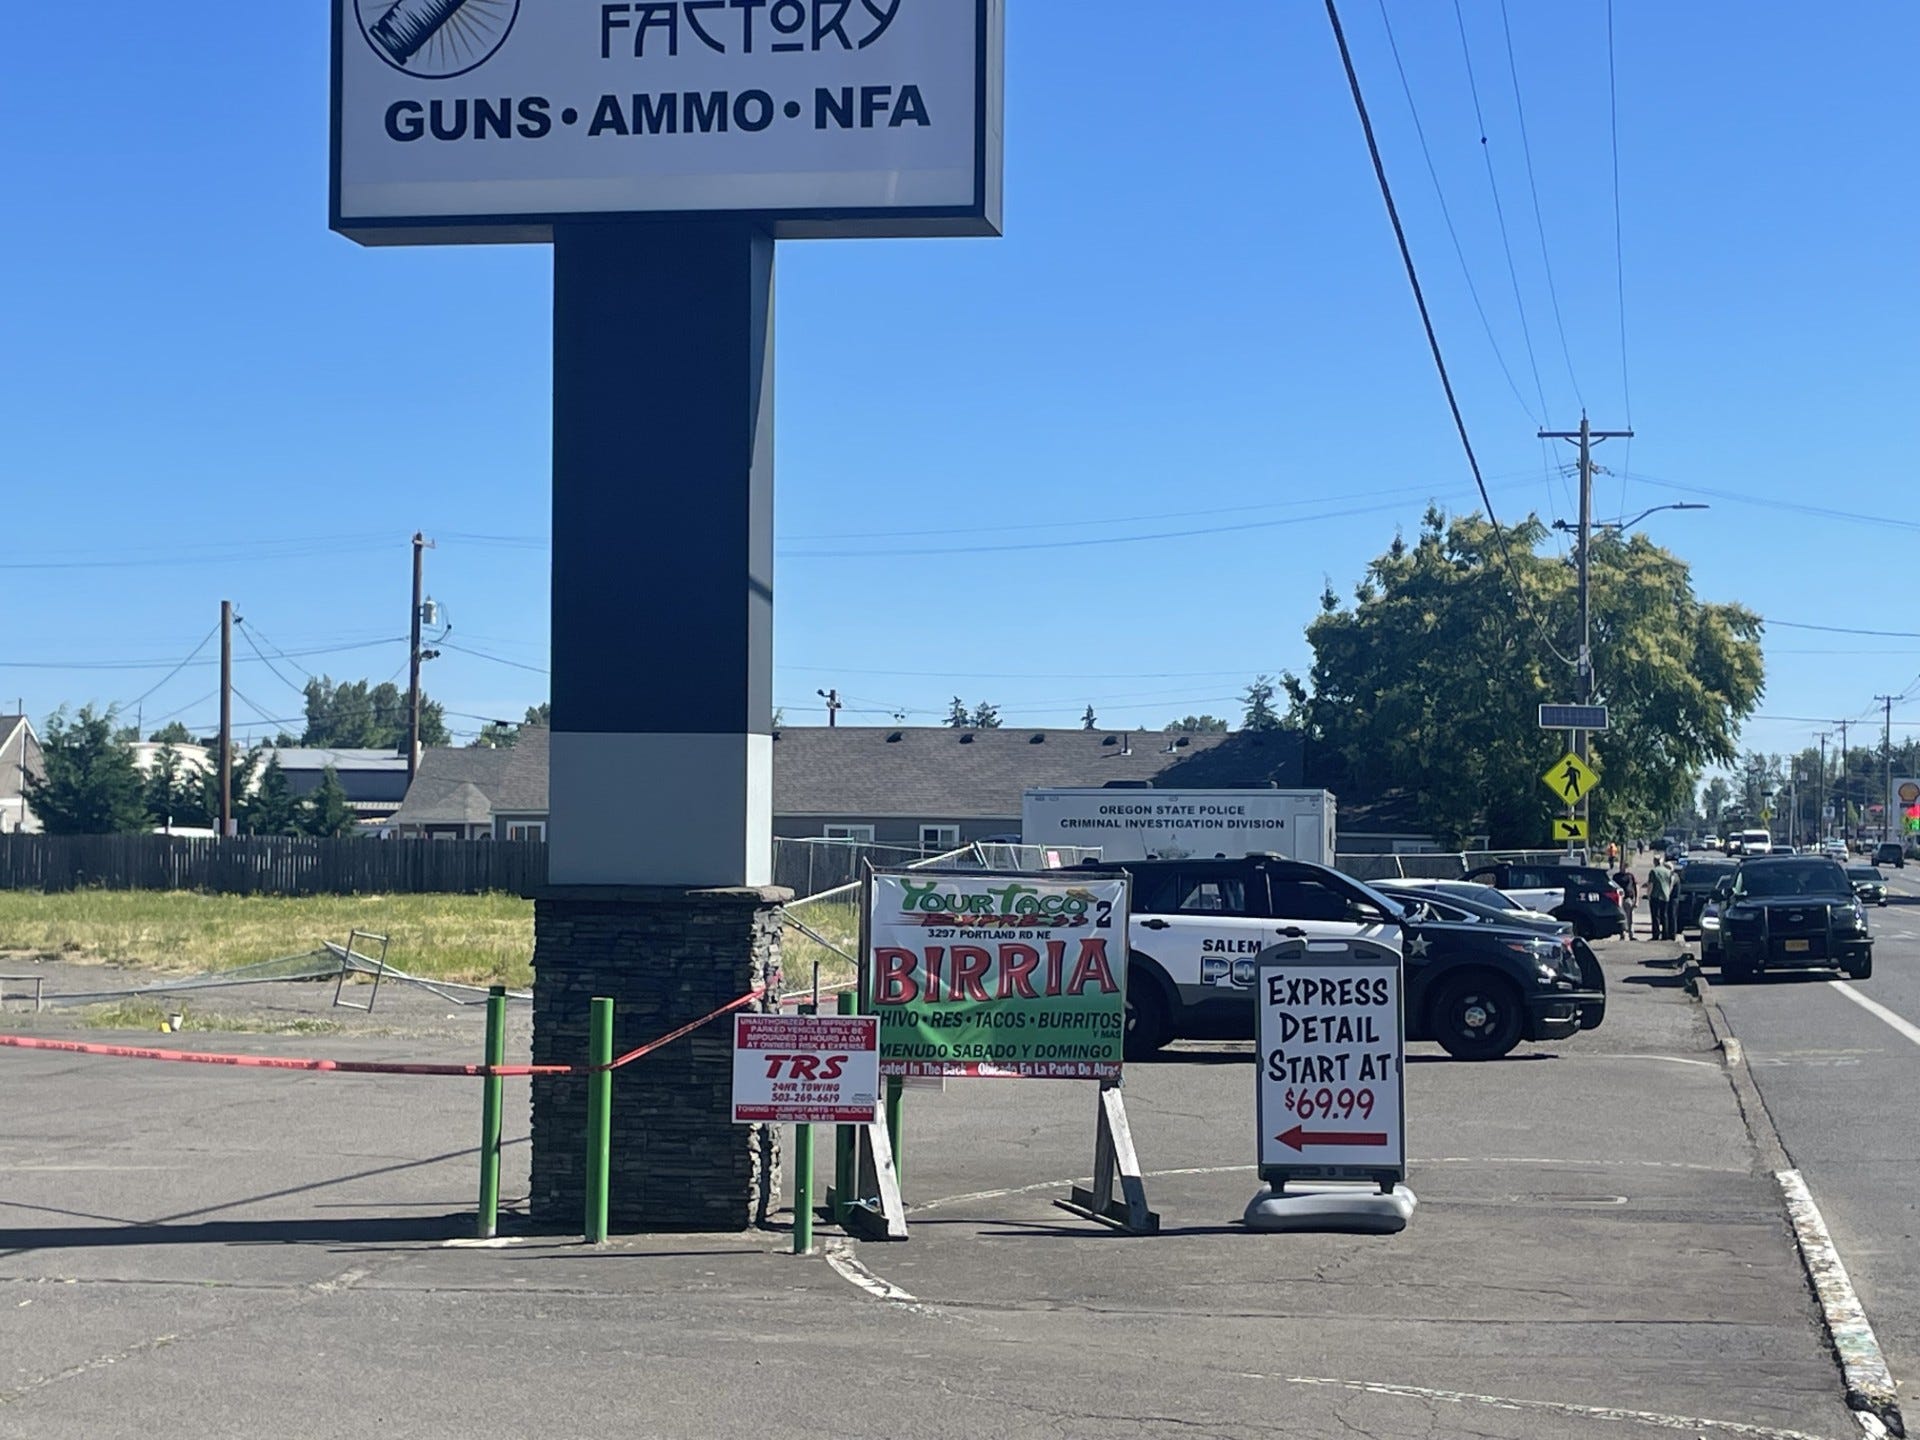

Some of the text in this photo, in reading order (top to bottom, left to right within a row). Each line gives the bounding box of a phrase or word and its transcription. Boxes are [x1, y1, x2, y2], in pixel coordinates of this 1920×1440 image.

[601, 0, 900, 58] FACTORY
[384, 85, 931, 142] GUNS AMMO NFA
[1099, 805, 1246, 816] OREGON STATE POLICE
[1060, 818, 1285, 829] CRIMINAL INVESTIGATION DIVISION
[900, 878, 1089, 915] YOUR TACO
[1096, 900, 1112, 928] 2
[928, 928, 1051, 940] 3297 PORTLAND RD NE
[1202, 939, 1262, 953] SALEM
[874, 938, 1120, 1006] BIRRIA
[1267, 974, 1389, 1006] EXPRESS
[870, 1010, 1121, 1029] HIVO RES TACOS BURRITOS
[1279, 1012, 1380, 1044] DETAIL
[880, 1043, 1113, 1058] MENUDO SABADO Y DOMINGO
[764, 1055, 848, 1080] TRS
[880, 1062, 907, 1074] cated
[909, 1063, 920, 1074] In
[923, 1062, 942, 1075] The
[1020, 1063, 1032, 1075] En
[1034, 1063, 1047, 1075] La
[1049, 1063, 1076, 1076] Parte
[1268, 1049, 1392, 1084] START AT
[771, 1083, 840, 1092] 24HR TOWING
[771, 1093, 840, 1103] 503-269-6619
[1284, 1087, 1375, 1120] $69.99
